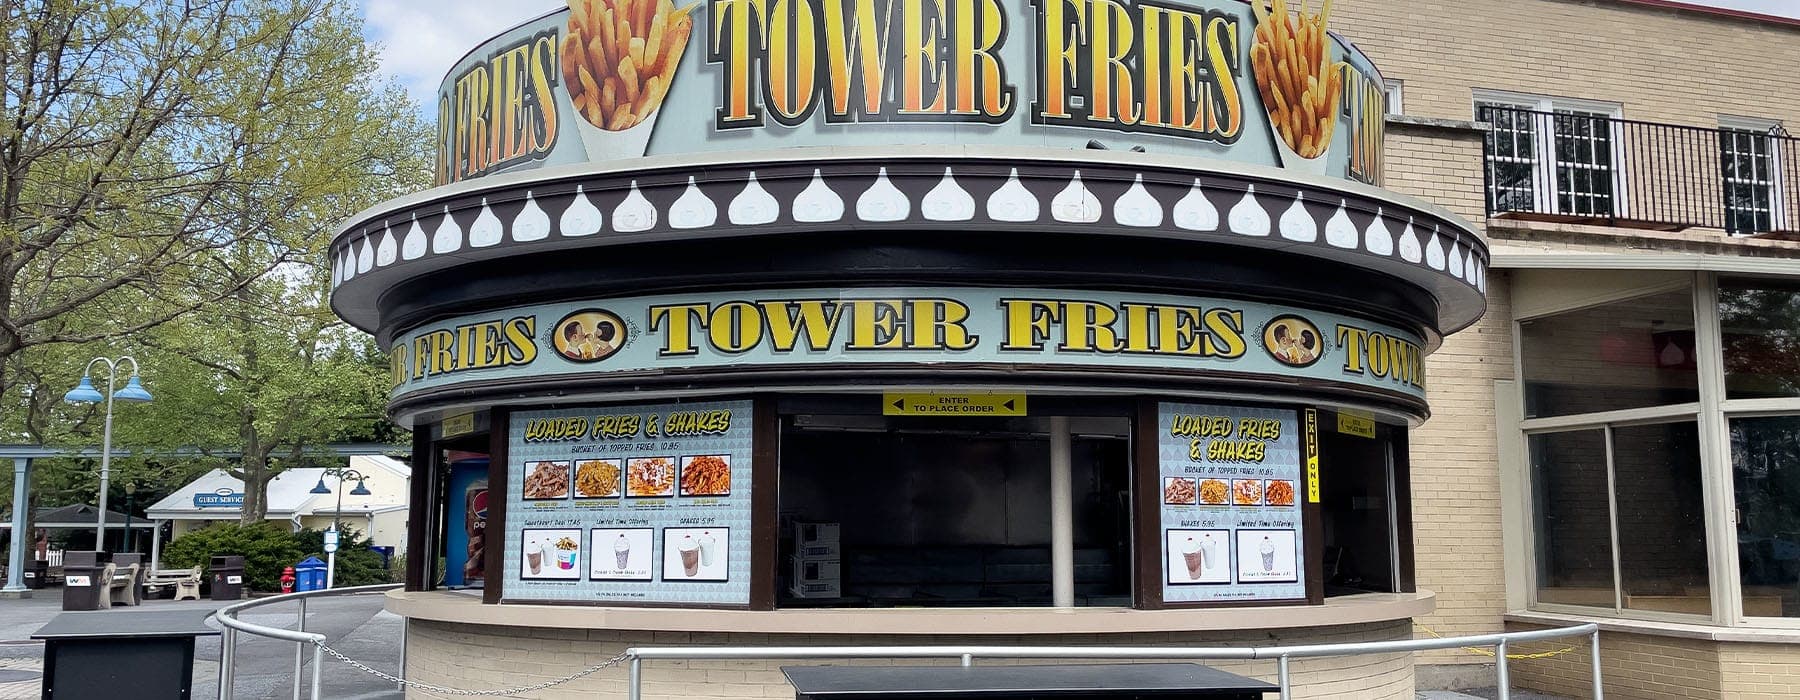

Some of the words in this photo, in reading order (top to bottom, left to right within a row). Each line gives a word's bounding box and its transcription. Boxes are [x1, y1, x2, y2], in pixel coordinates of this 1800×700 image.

[708, 0, 1016, 127] TOWER
[1035, 0, 1242, 142] FRIES
[454, 33, 559, 181] FRIES
[413, 315, 537, 379] FRIES
[650, 298, 980, 356] TOWER
[1000, 298, 1247, 359] FRIES
[525, 418, 588, 442] LOADED
[592, 415, 641, 438] FRIES
[646, 414, 659, 438] &
[665, 410, 733, 436] SHAKES
[610, 443, 633, 452] TOPPED
[1171, 415, 1232, 438] LOADED
[1238, 418, 1281, 440] FRIES
[1189, 439, 1200, 462] &
[1208, 441, 1267, 463] SHAKES
